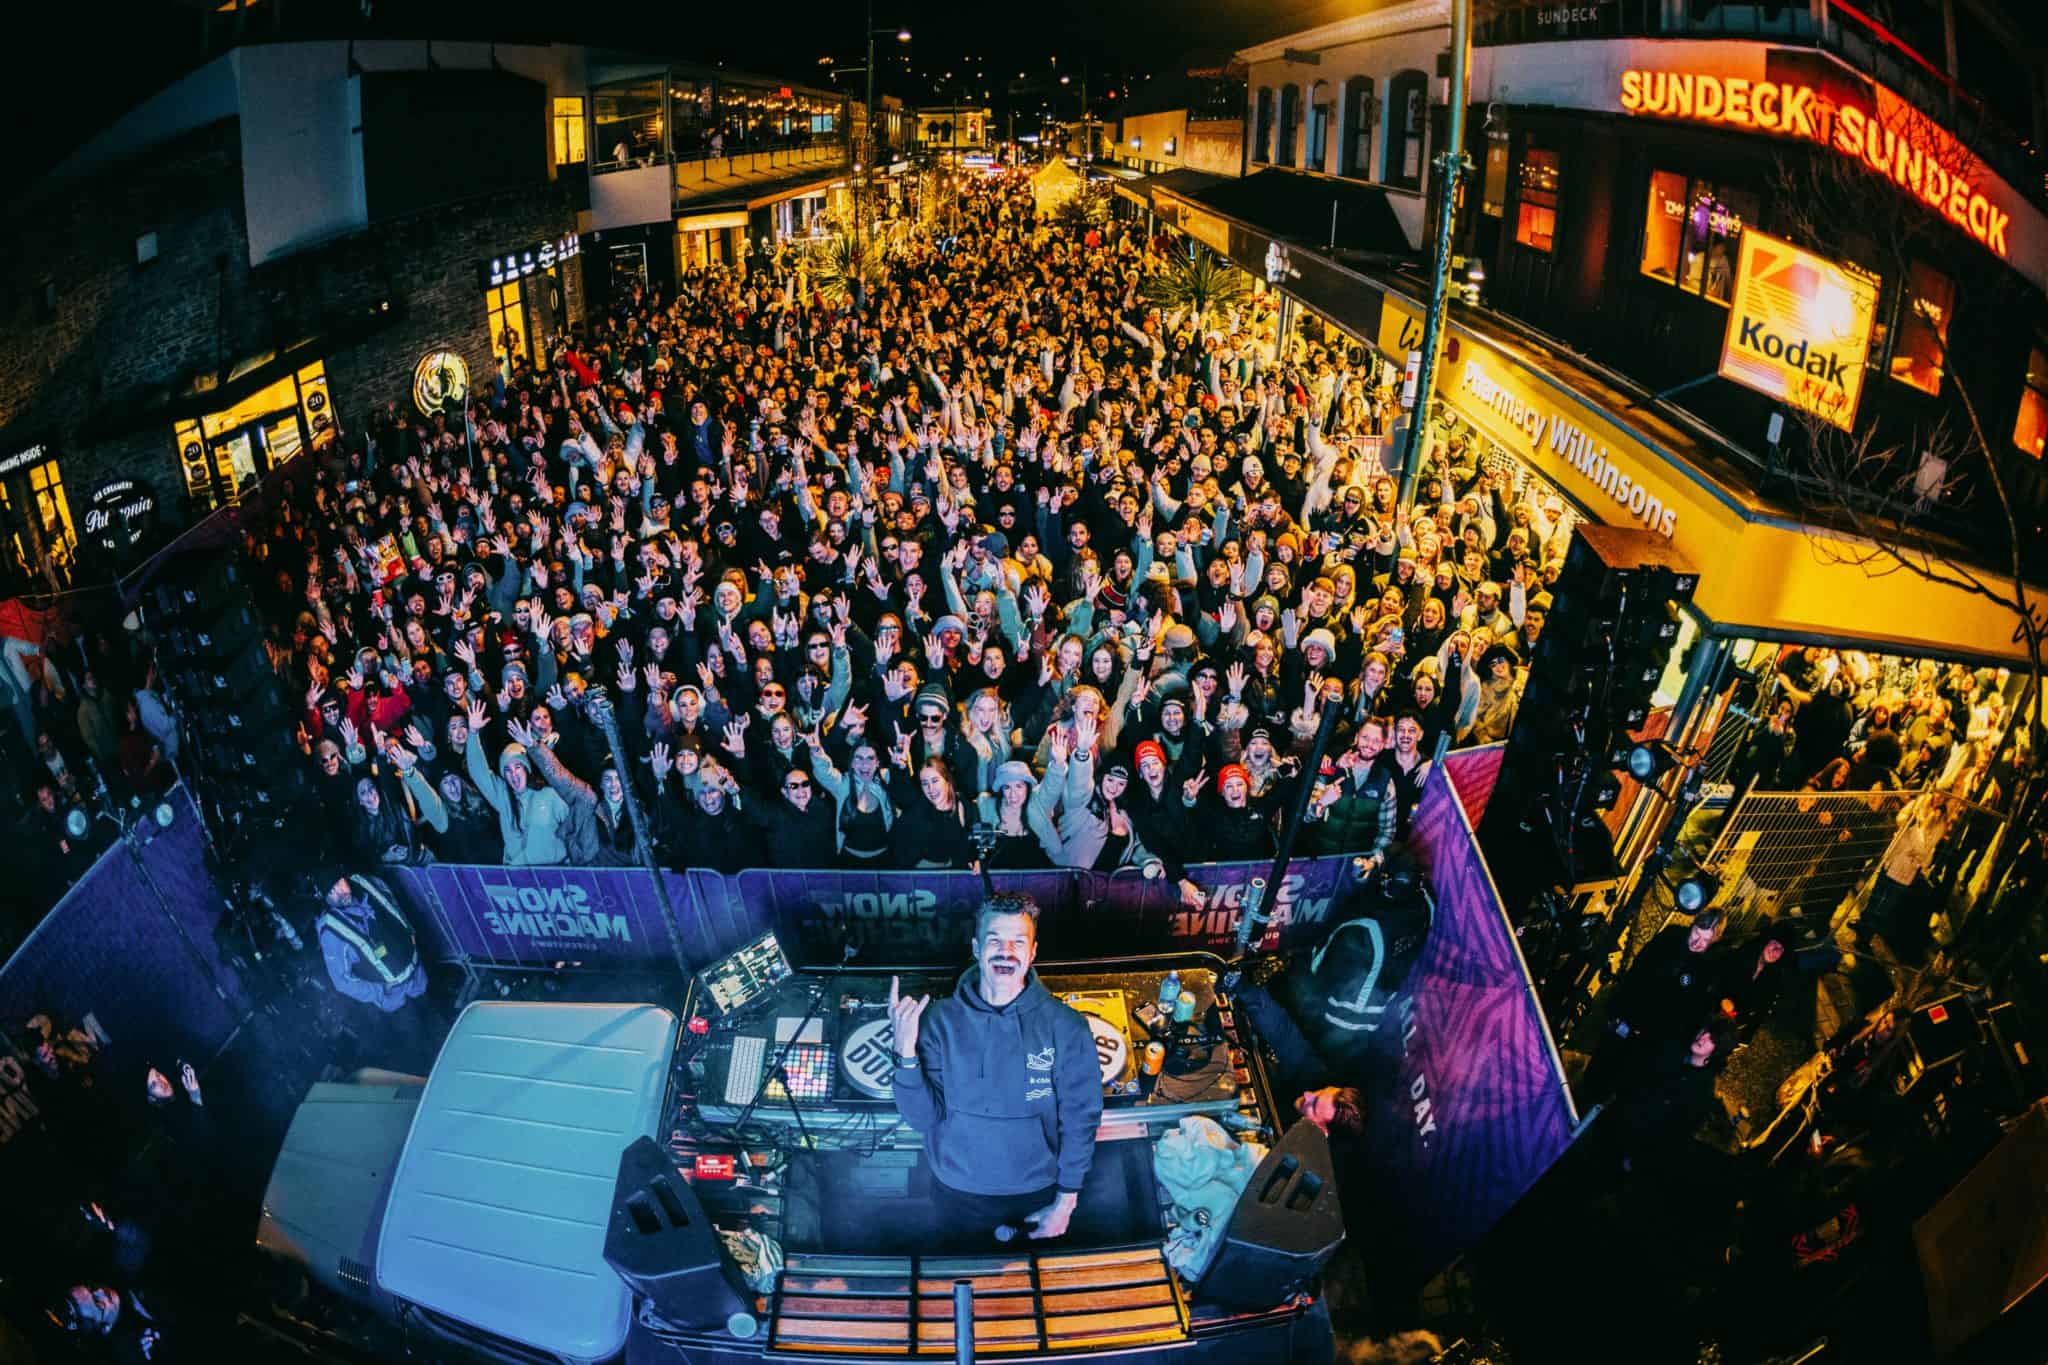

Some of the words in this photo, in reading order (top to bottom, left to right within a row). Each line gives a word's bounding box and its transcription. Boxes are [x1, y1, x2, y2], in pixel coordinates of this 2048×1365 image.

[1537, 8, 1598, 25] SUNDECK
[1620, 70, 1815, 136] SUNDECK
[1836, 104, 2010, 256] SUNDECK
[1739, 316, 1849, 389] Kodak
[1463, 359, 1549, 449] Pharmacy
[1550, 414, 1678, 539] Wilkinsons
